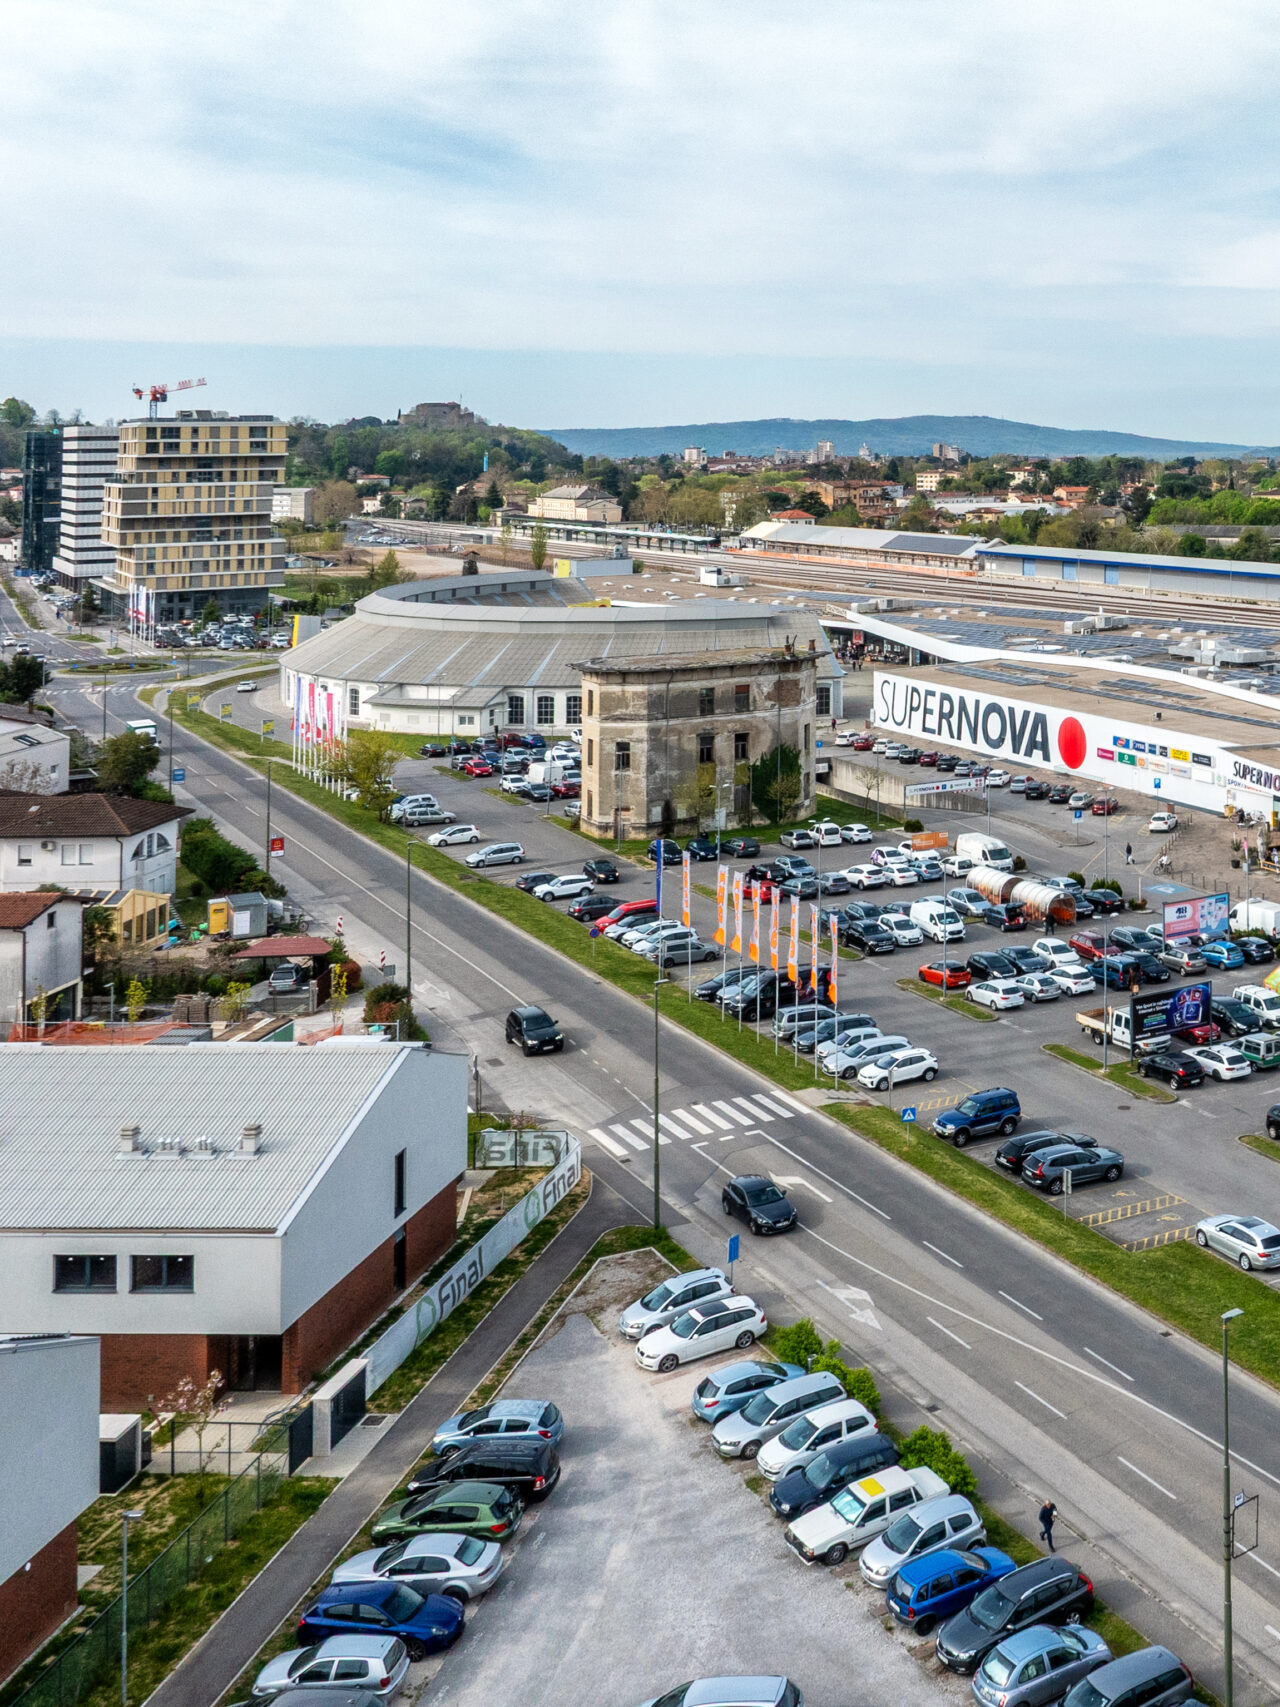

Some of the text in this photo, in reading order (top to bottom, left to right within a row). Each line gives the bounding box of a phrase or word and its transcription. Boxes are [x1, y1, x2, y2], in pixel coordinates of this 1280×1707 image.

[879, 679, 1051, 762] SUPERNOVA
[543, 1150, 580, 1213] Final
[438, 1245, 484, 1320] Final
